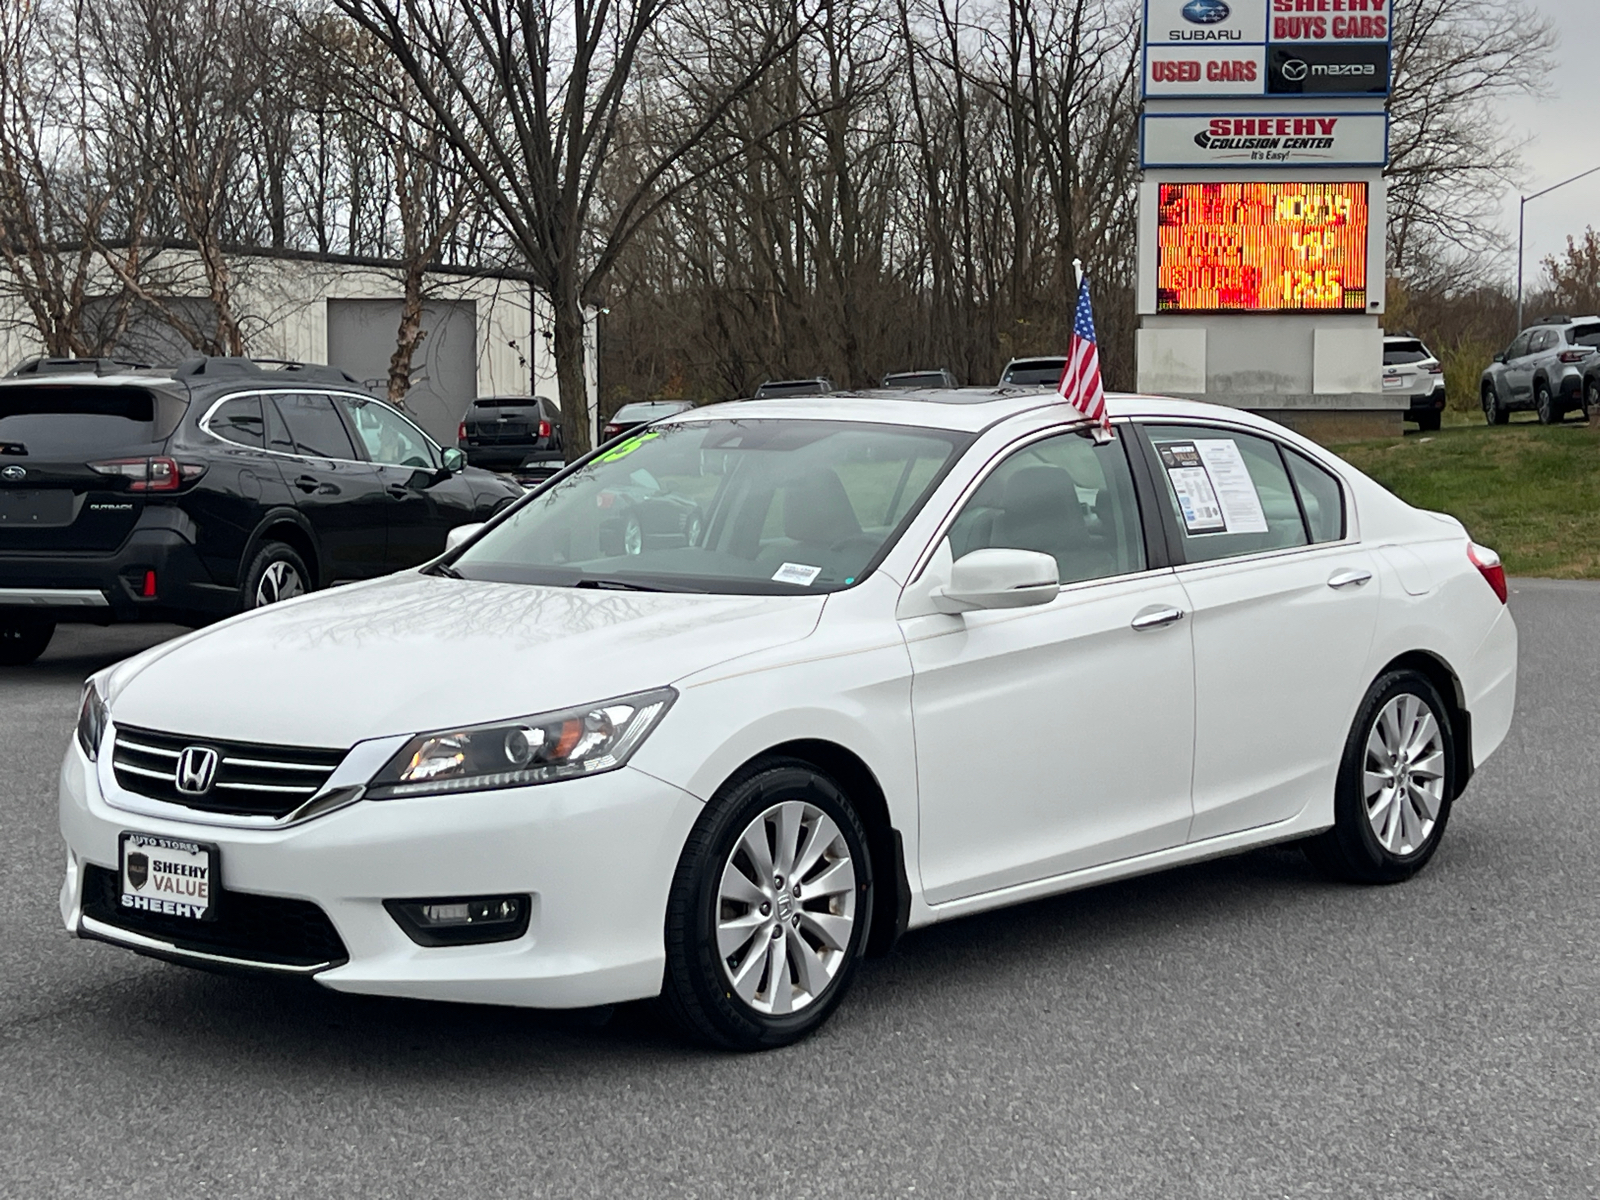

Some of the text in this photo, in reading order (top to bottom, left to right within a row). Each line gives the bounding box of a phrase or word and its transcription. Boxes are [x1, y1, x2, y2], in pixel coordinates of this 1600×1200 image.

[1273, 0, 1385, 11] SHEEHY
[1169, 30, 1241, 40] SUBARU
[1273, 16, 1387, 39] BUYS CARS
[1151, 60, 1257, 82] USED CARS
[1311, 64, 1375, 75] mazda
[1209, 118, 1338, 136] SHEEHY
[1209, 137, 1335, 149] COLLISION CENTER
[1250, 150, 1291, 162] It's Easy!
[129, 835, 199, 852] AUTO STORES
[153, 860, 208, 878] SHEEHY
[153, 874, 208, 898] VALUE
[121, 893, 206, 919] SHEEHY
